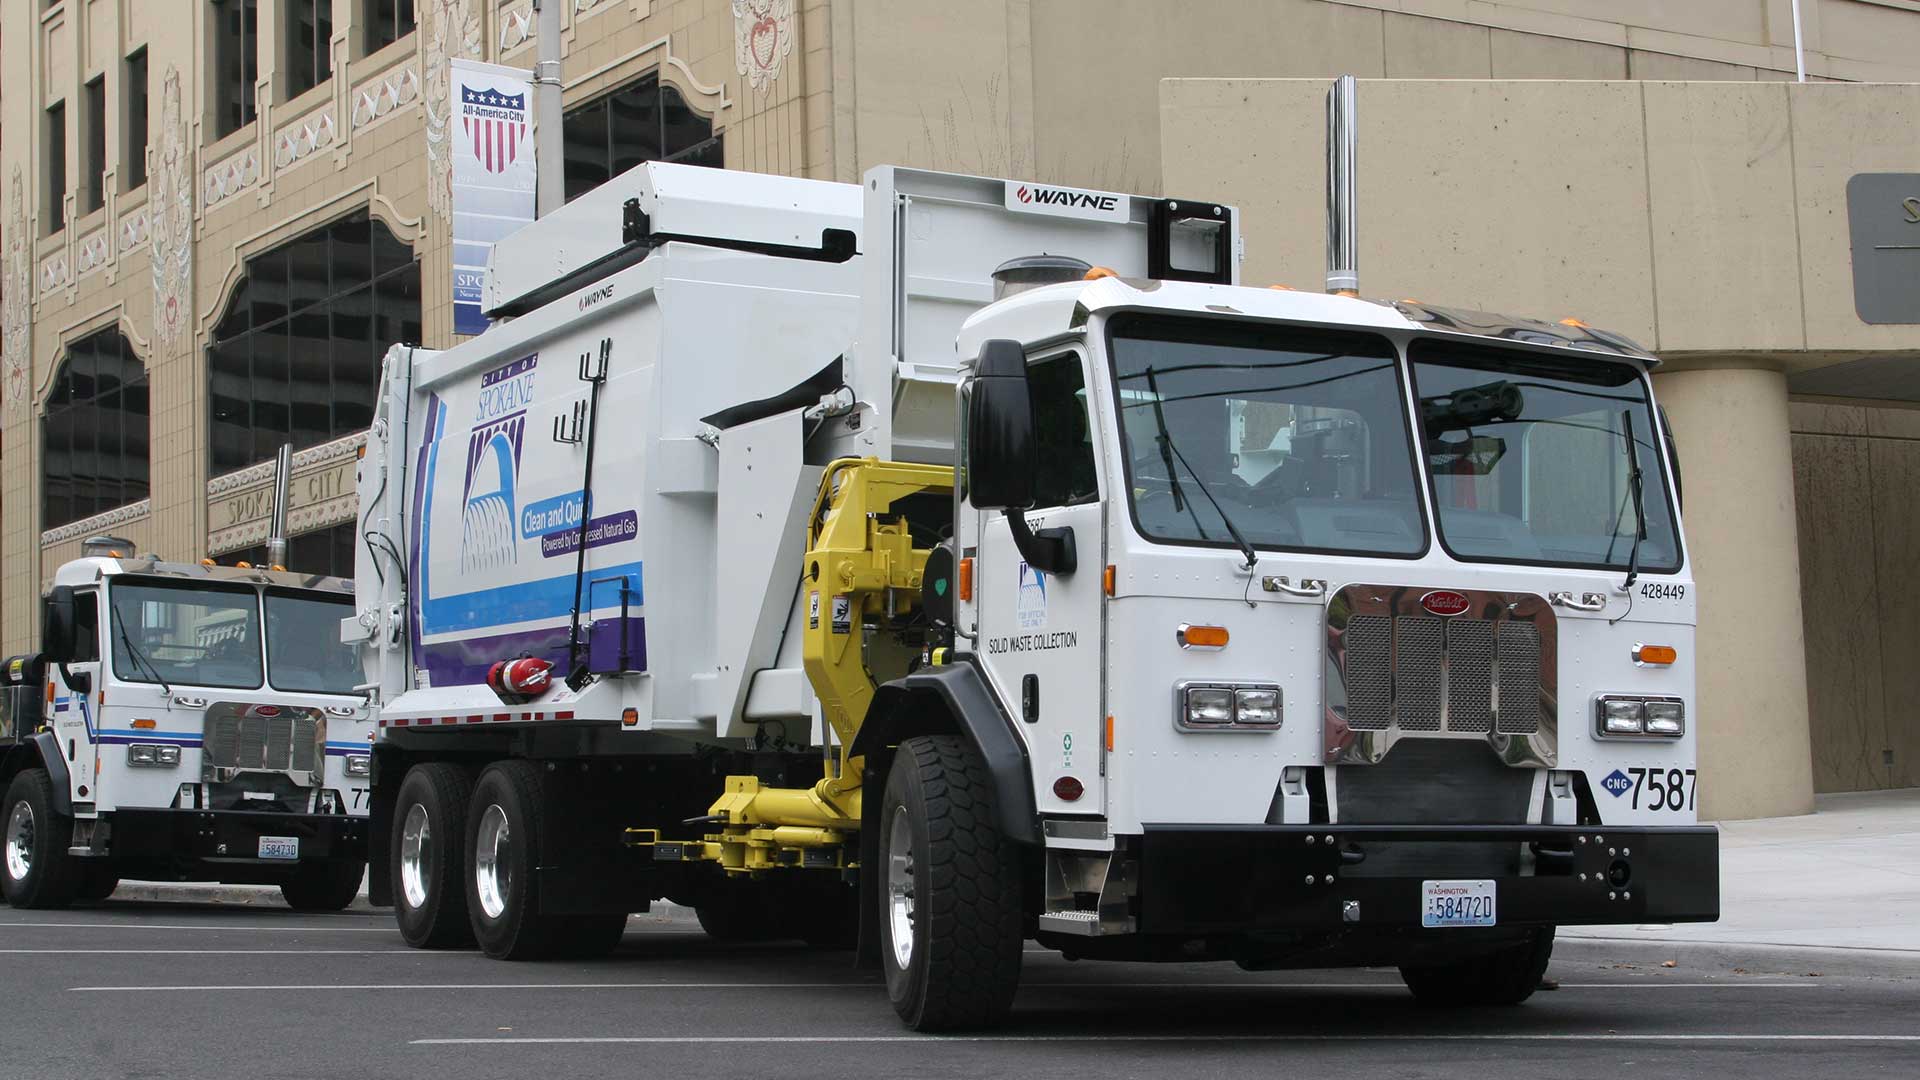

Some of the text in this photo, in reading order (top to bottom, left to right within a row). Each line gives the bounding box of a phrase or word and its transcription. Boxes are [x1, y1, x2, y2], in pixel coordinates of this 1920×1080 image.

[463, 105, 524, 122] All-America City
[1034, 189, 1118, 211] WAYNE
[584, 284, 614, 307] WAYNE
[483, 356, 537, 386] CITY OF
[476, 373, 536, 421] SPOKANE
[228, 468, 343, 524] SPOKAE CITY
[524, 498, 589, 533] Clean and Qui
[543, 519, 636, 552] Powered by Comressed Natural Gas
[1640, 583, 1685, 600] 428449
[989, 632, 1077, 654] SOLID WASTE COLLECTION
[1607, 778, 1628, 790] CNG
[1628, 768, 1697, 811] 7587
[1436, 896, 1492, 919] 58472D
